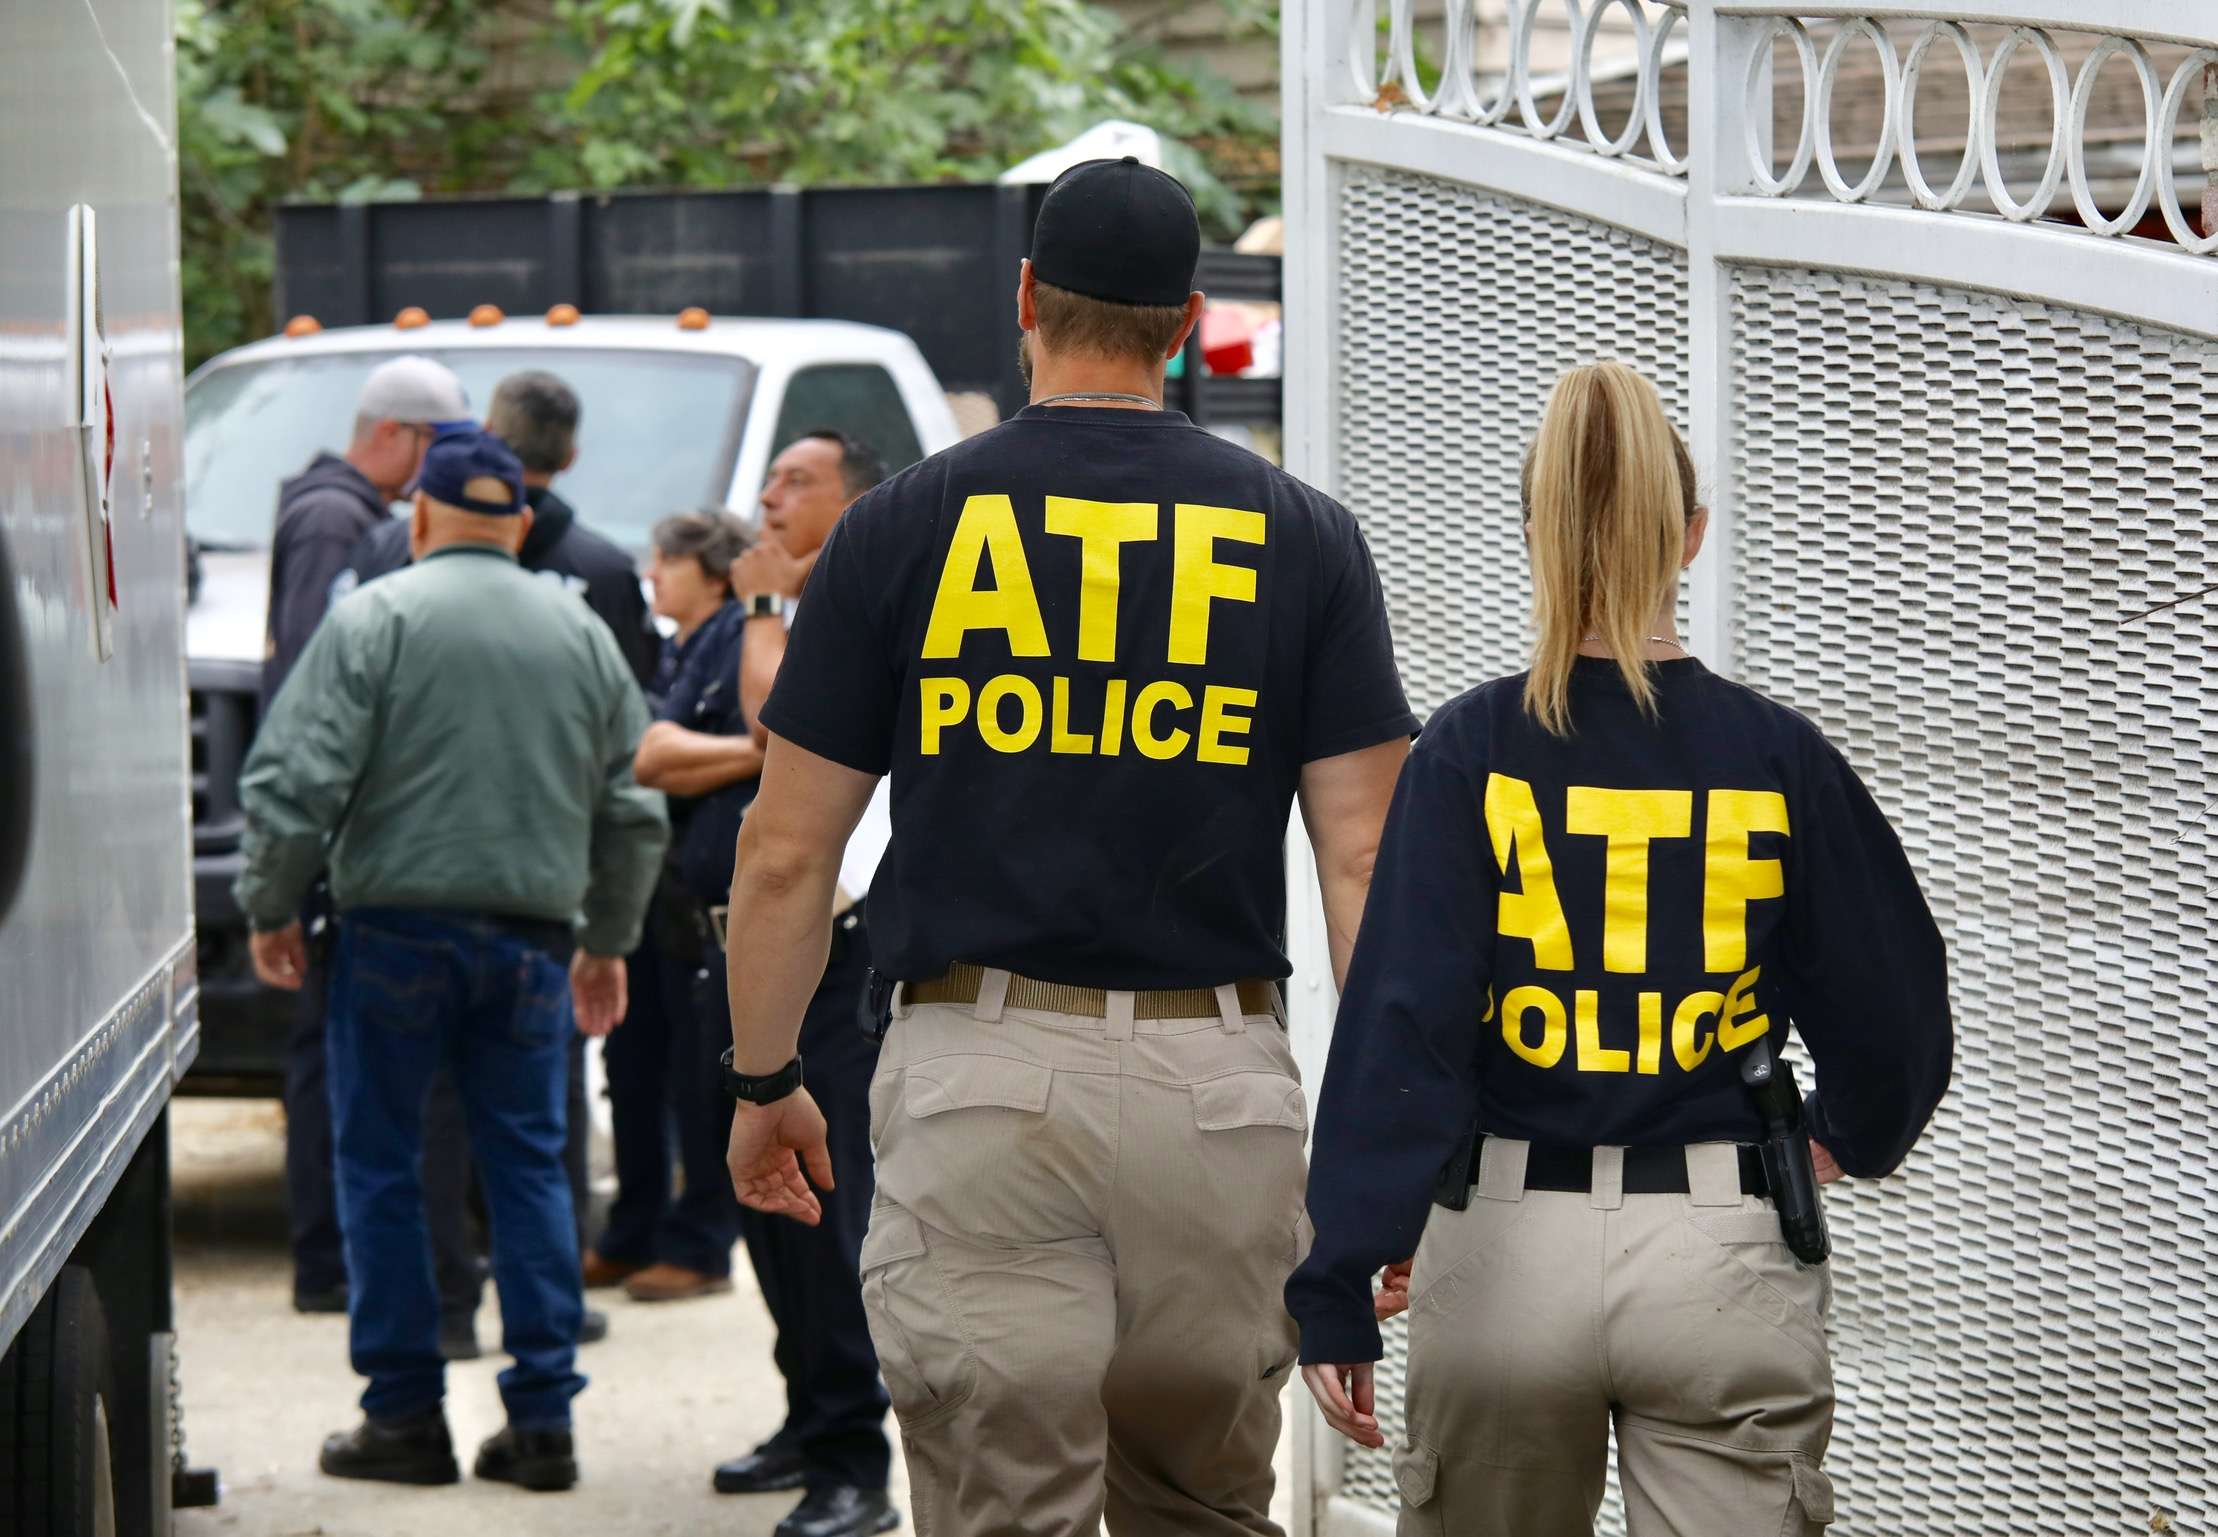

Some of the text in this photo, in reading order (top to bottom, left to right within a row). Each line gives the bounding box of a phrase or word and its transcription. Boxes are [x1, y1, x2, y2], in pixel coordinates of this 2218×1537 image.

[920, 493, 1267, 666] ATF
[919, 674, 1259, 767] POLICE
[1483, 772, 1791, 974] ATF
[1481, 965, 1770, 1075] OLICE
